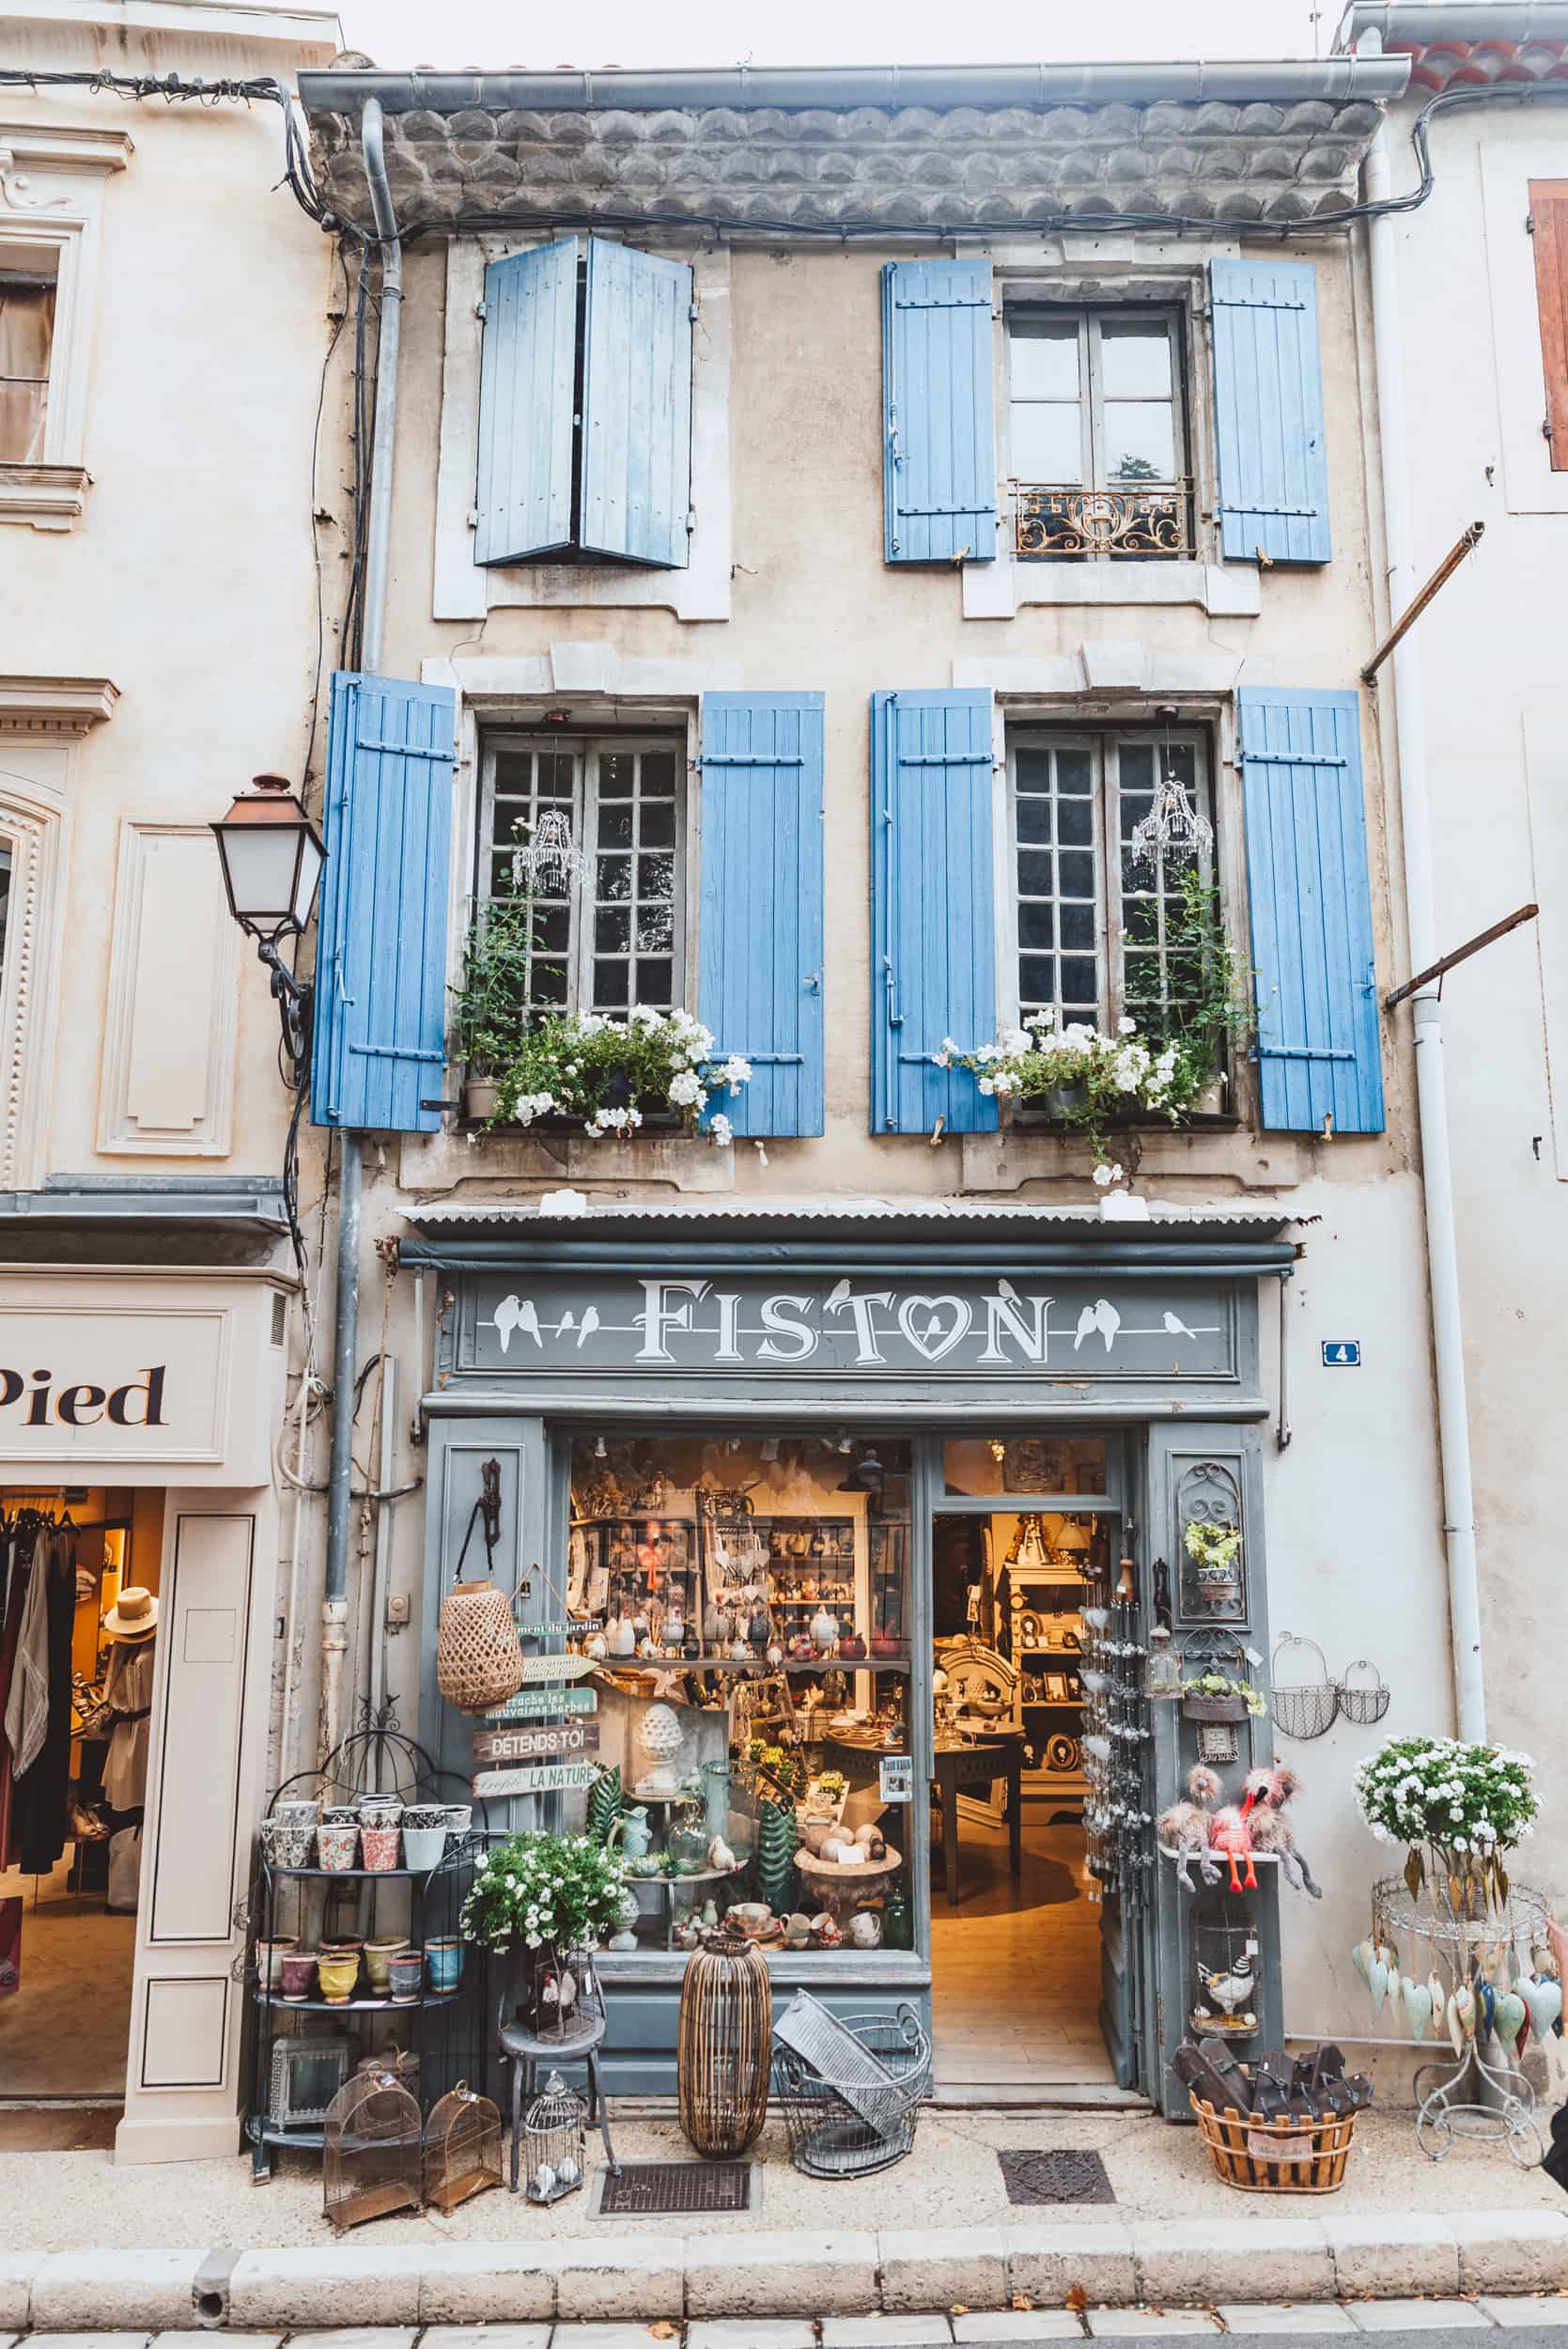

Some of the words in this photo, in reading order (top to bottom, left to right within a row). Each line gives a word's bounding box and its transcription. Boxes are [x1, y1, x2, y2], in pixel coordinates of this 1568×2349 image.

[1336, 1345, 1347, 1361] 4
[514, 1624, 545, 1634] ment
[565, 1621, 599, 1633] jardin
[506, 1692, 545, 1707] rrache
[548, 1691, 565, 1704] les
[486, 1703, 548, 1719] mauvaises
[551, 1700, 590, 1714] herbes
[530, 1768, 546, 1788] LA
[549, 1766, 596, 1786] NATURE
